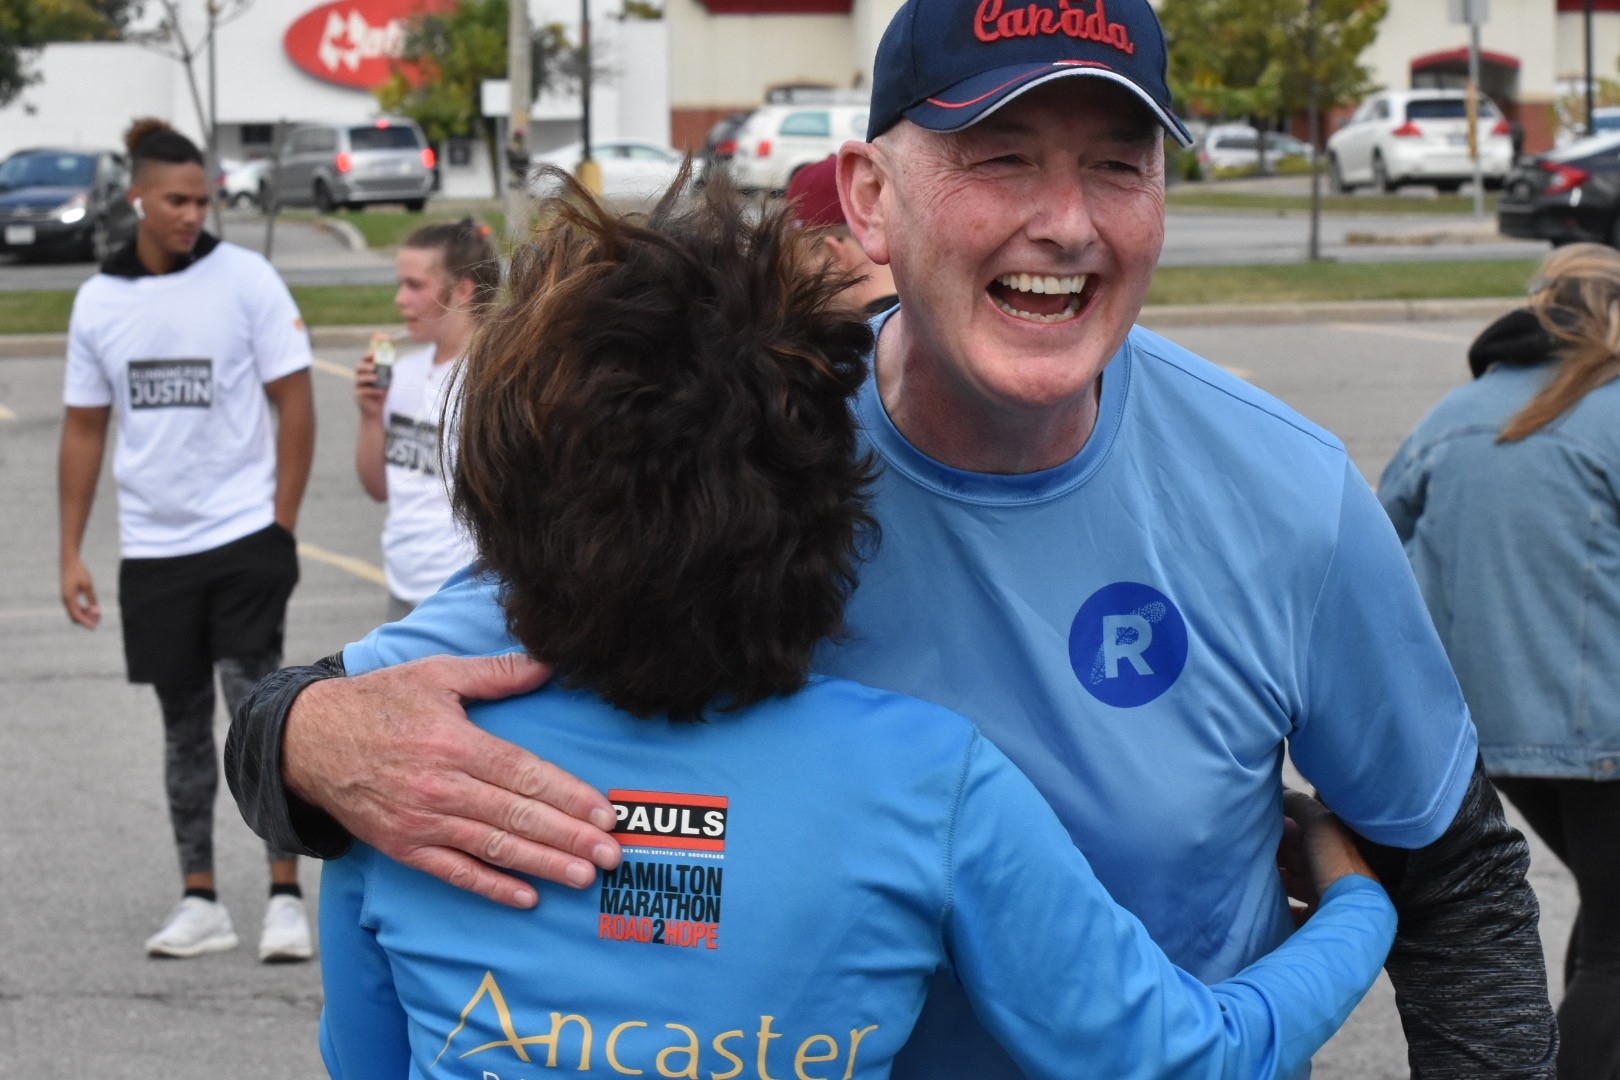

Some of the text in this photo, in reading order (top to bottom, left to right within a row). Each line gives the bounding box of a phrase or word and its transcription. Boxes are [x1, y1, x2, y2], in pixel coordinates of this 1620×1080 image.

[974, 0, 1136, 55] Canada
[131, 379, 211, 406] JUSTIN
[1101, 613, 1156, 679] R
[611, 804, 725, 837] PAULS
[602, 860, 723, 896] HAMILTON
[600, 888, 721, 923] MARATHON
[430, 969, 878, 1080] Ancaster
